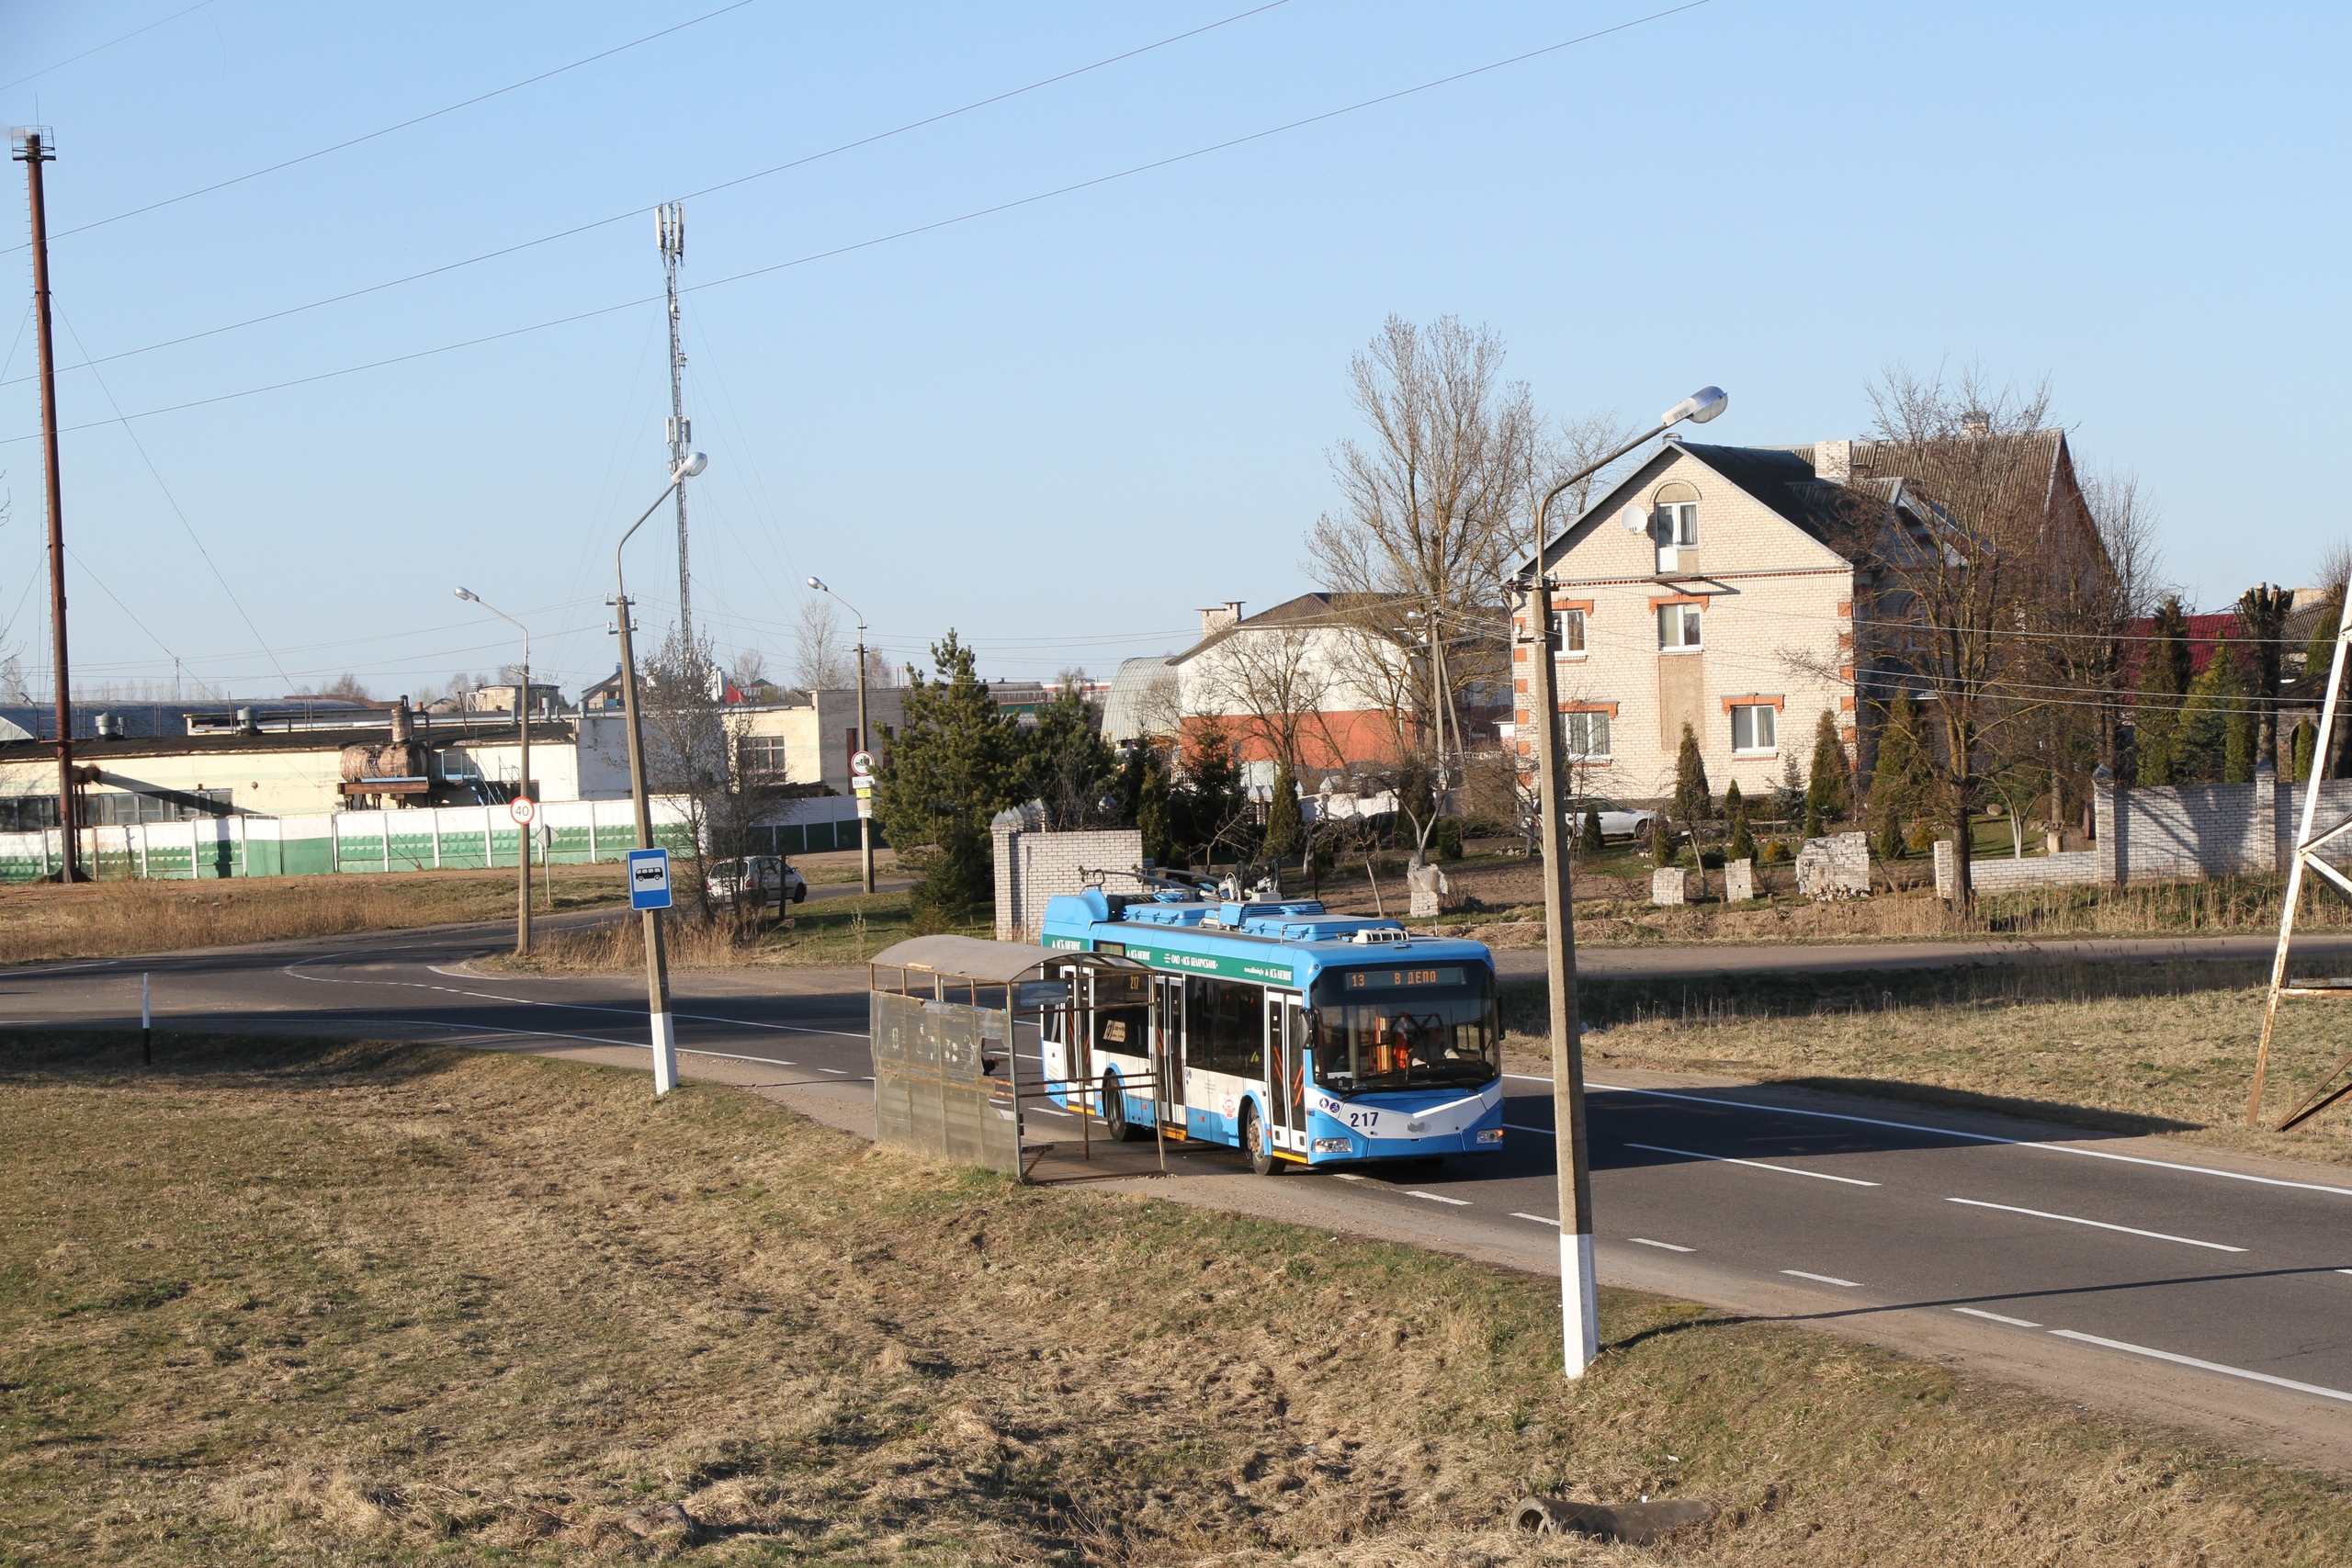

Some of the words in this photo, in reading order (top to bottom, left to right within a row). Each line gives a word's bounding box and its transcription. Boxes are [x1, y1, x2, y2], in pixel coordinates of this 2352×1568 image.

[515, 806, 529, 817] 40
[1171, 954, 1180, 964] ОАО
[1130, 976, 1139, 989] 217
[1351, 974, 1365, 987] 13
[1395, 972, 1401, 985] В
[1408, 970, 1436, 985] ДЕПО
[1351, 1111, 1379, 1127] 217
